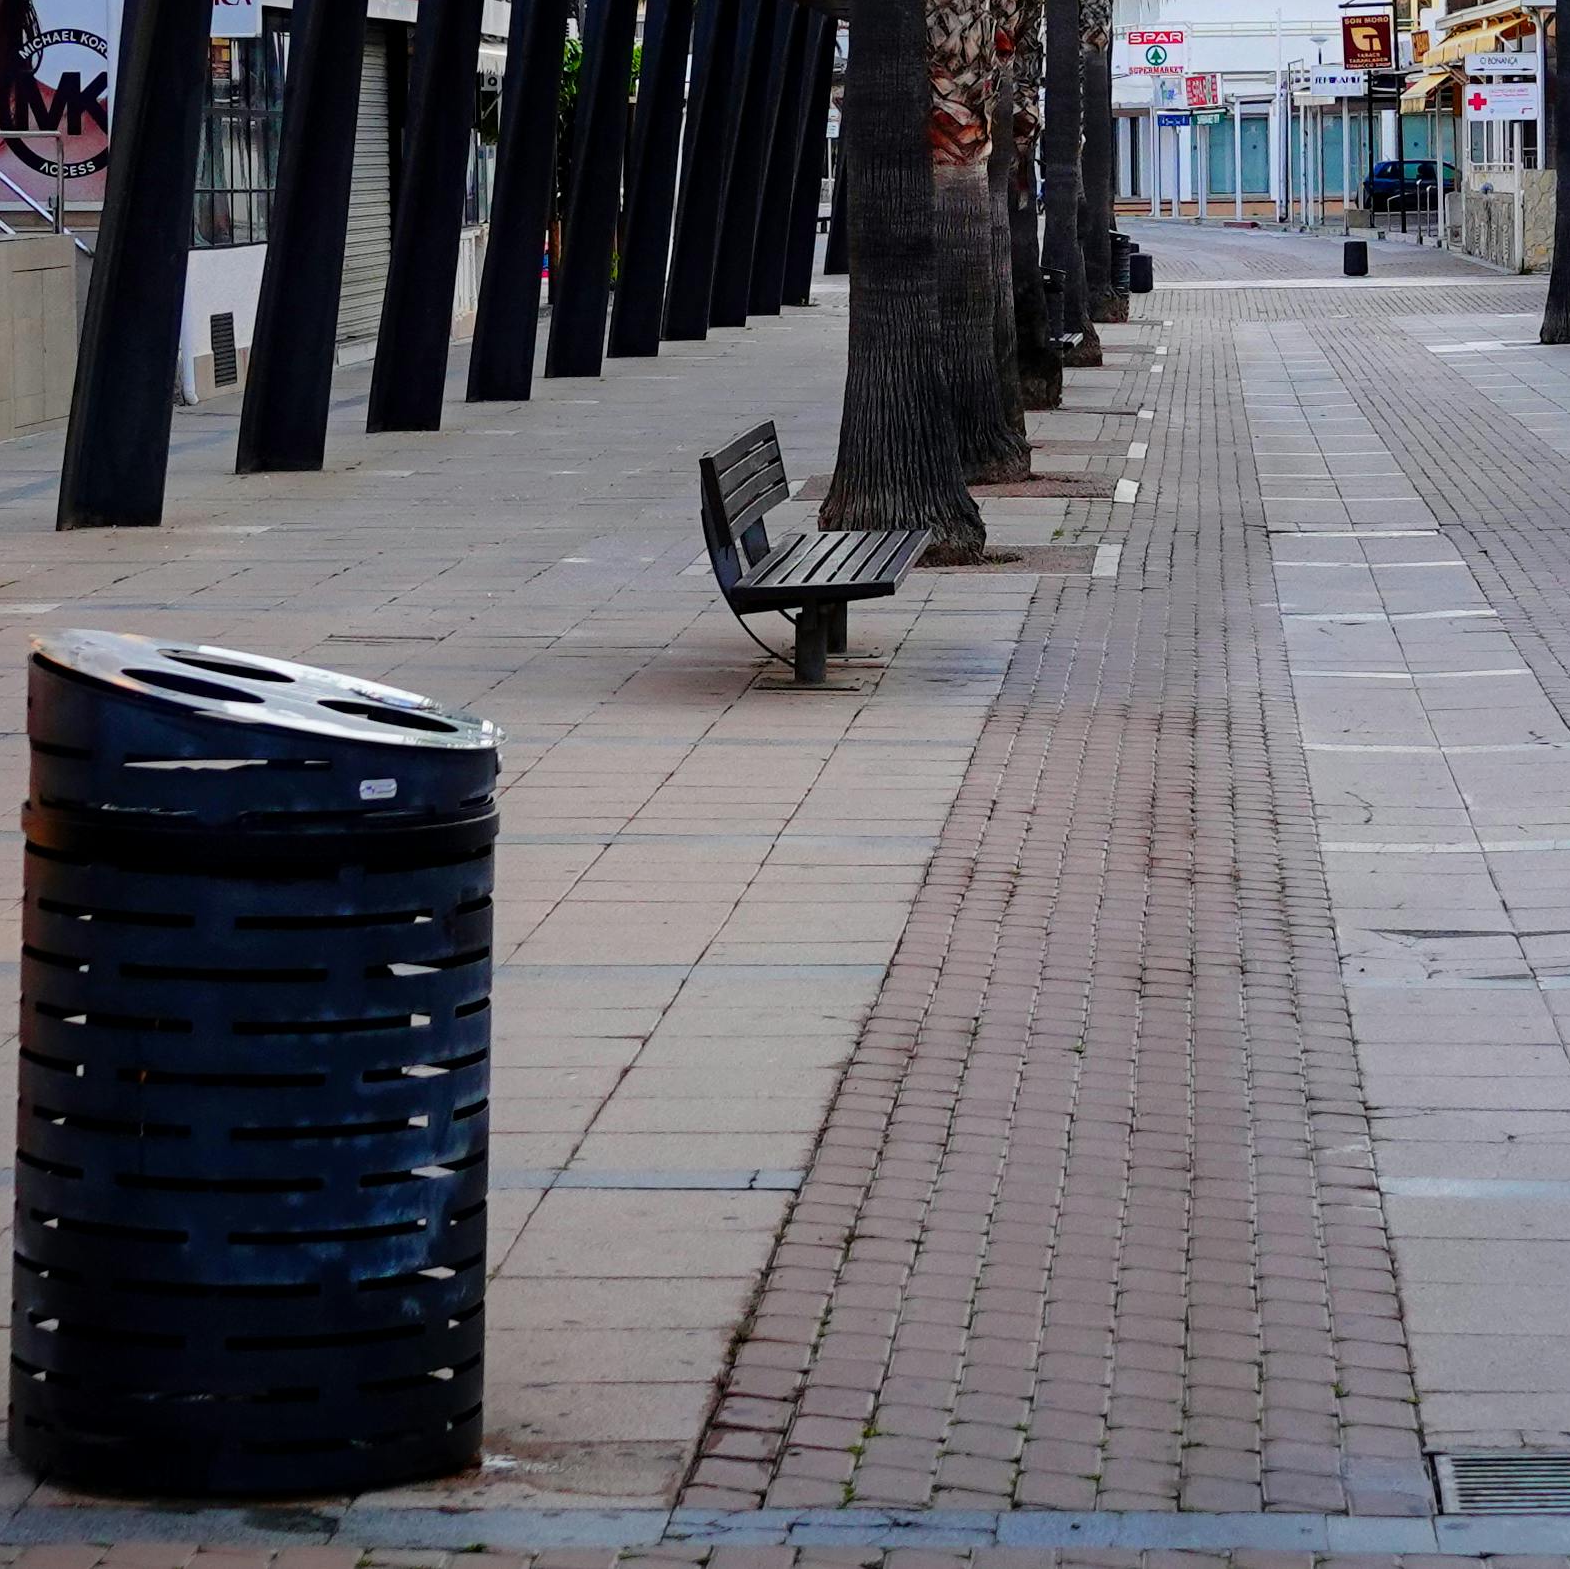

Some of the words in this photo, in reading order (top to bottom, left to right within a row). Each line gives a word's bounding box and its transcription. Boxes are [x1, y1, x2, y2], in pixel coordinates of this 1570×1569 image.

[1130, 32, 1182, 43] SPAR
[18, 30, 77, 60] MICHAEL
[80, 33, 108, 56] KOR
[1129, 65, 1184, 75] SUPERMARKET
